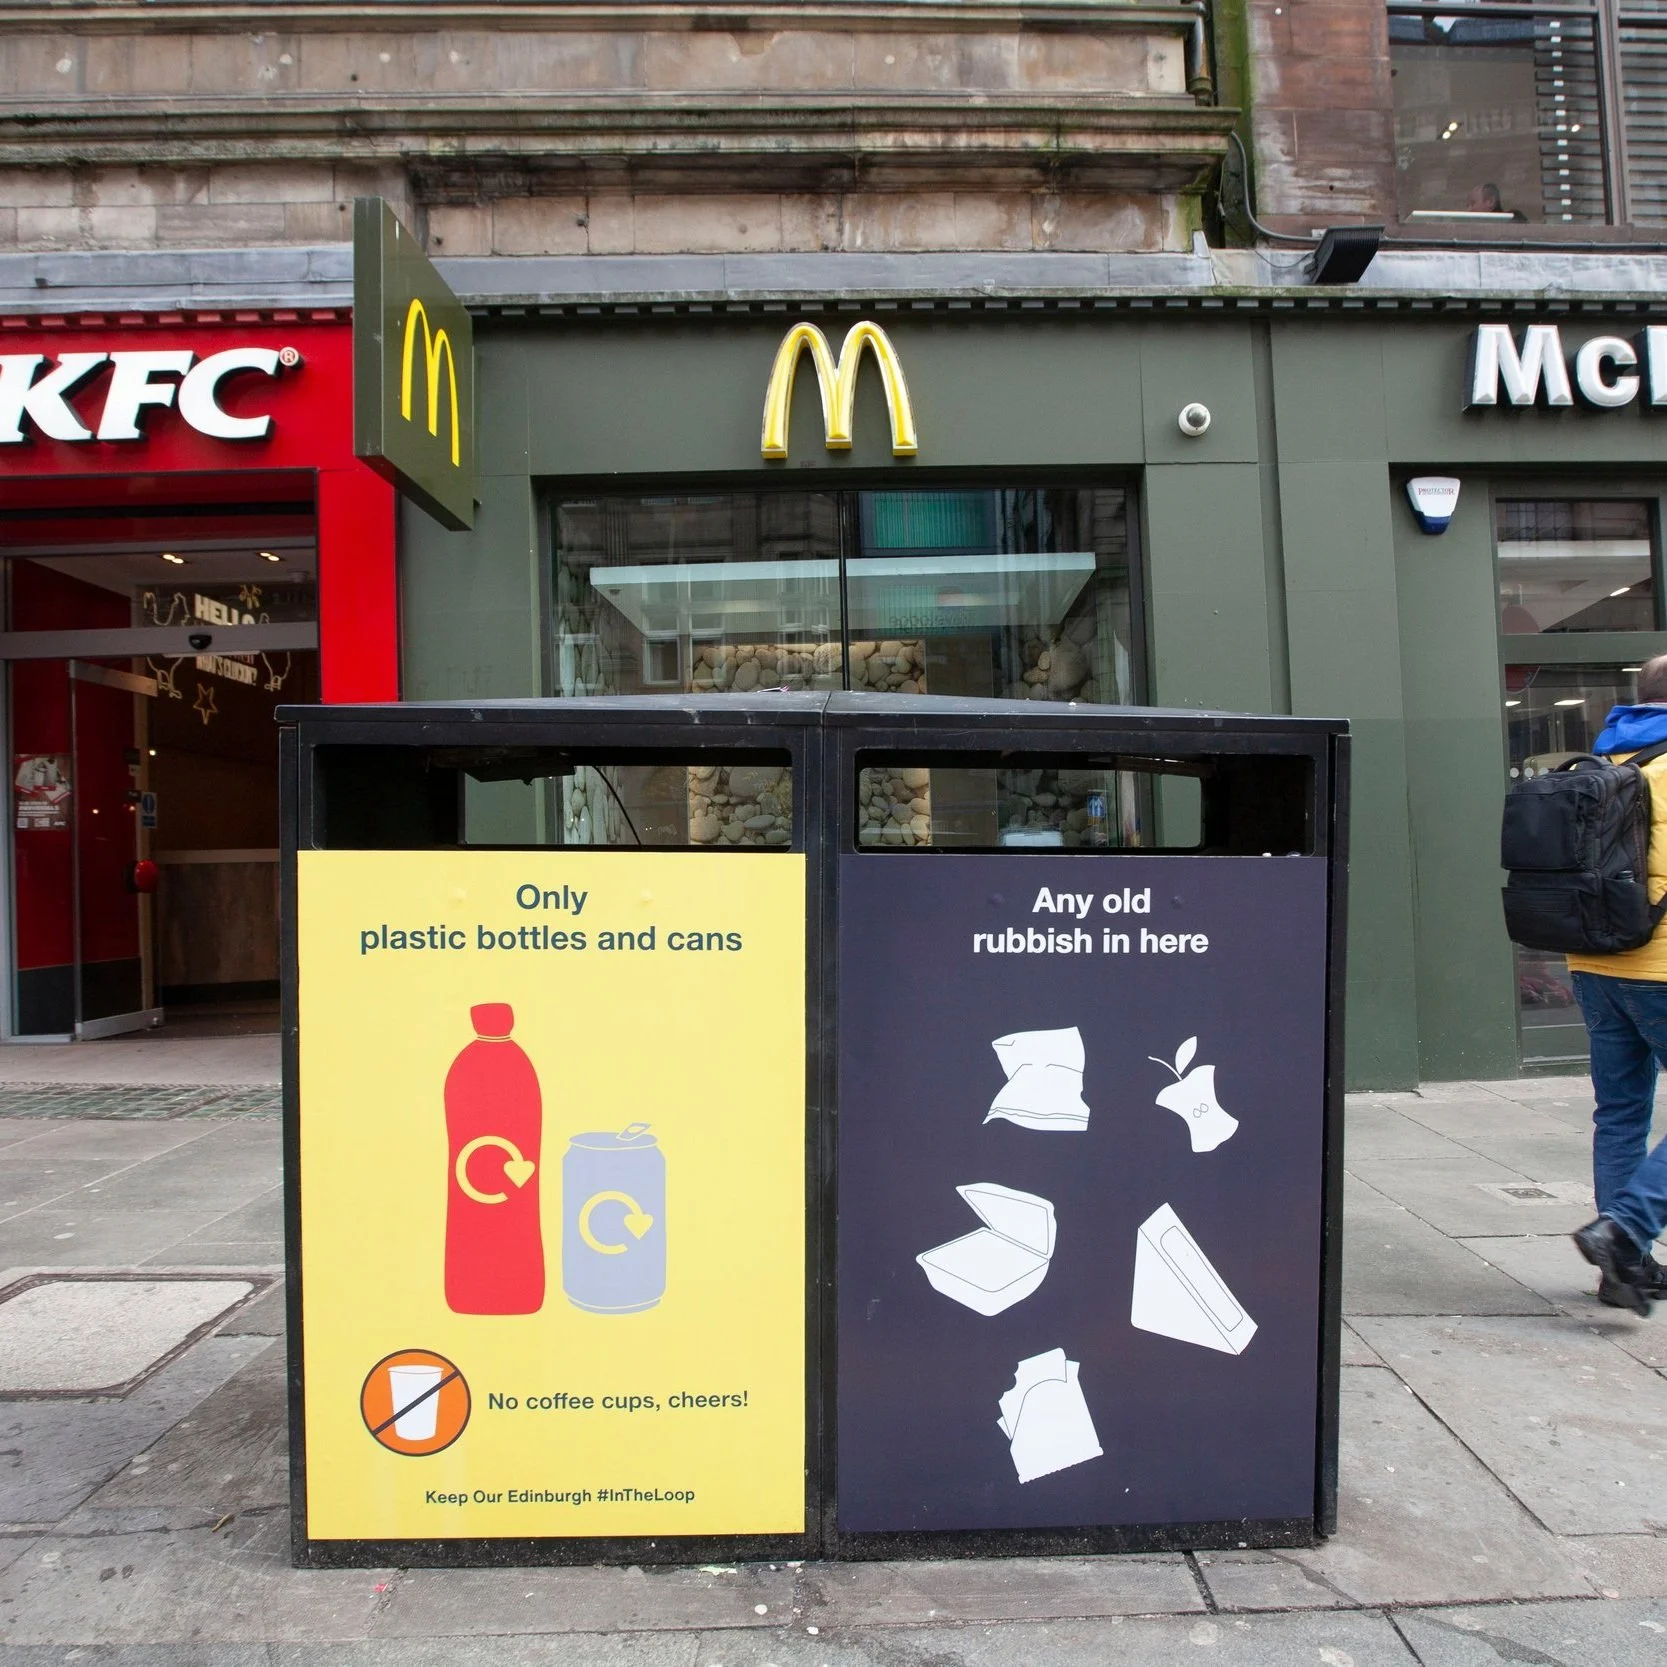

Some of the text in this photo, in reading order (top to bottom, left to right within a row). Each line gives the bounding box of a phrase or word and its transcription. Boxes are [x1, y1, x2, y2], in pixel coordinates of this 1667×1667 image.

[1471, 323, 1667, 407] Mc
[1418, 487, 1456, 496] PROTECTOR
[516, 883, 588, 916] Only
[1031, 886, 1151, 920] Any old
[361, 924, 742, 955] plastic bottles and cans
[973, 927, 1209, 954] rubbish in here
[488, 1390, 749, 1413] No coffee cups, cheers!
[426, 1488, 695, 1507] Keep Our Edinburgh #InTheLoop
